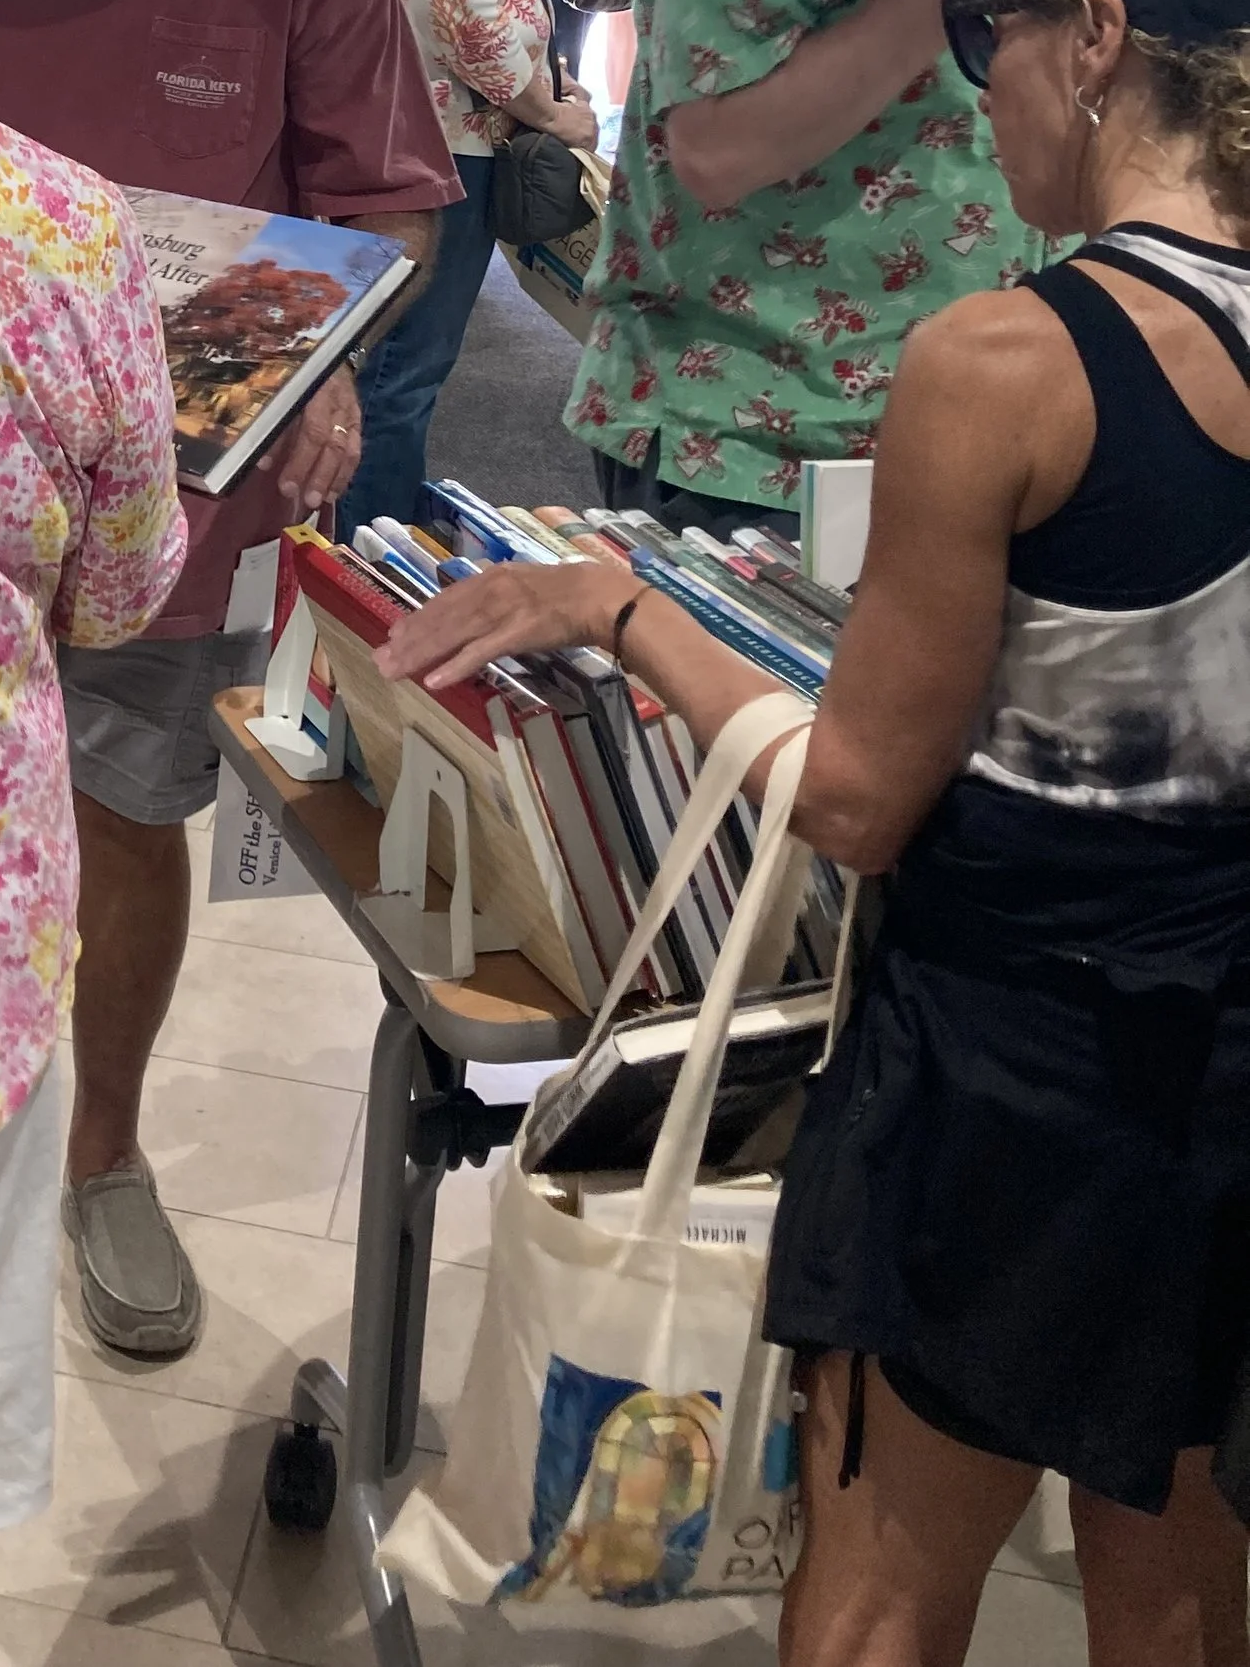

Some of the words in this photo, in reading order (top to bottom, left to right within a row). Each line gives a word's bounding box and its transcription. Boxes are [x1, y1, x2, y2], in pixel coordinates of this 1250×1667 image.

[156, 71, 207, 90] FLORIDA
[209, 80, 242, 94] KEYS
[554, 236, 596, 268] AGE
[151, 262, 209, 286] After
[243, 820, 262, 847] the
[238, 847, 260, 886] OFF
[262, 839, 282, 886] Venice
